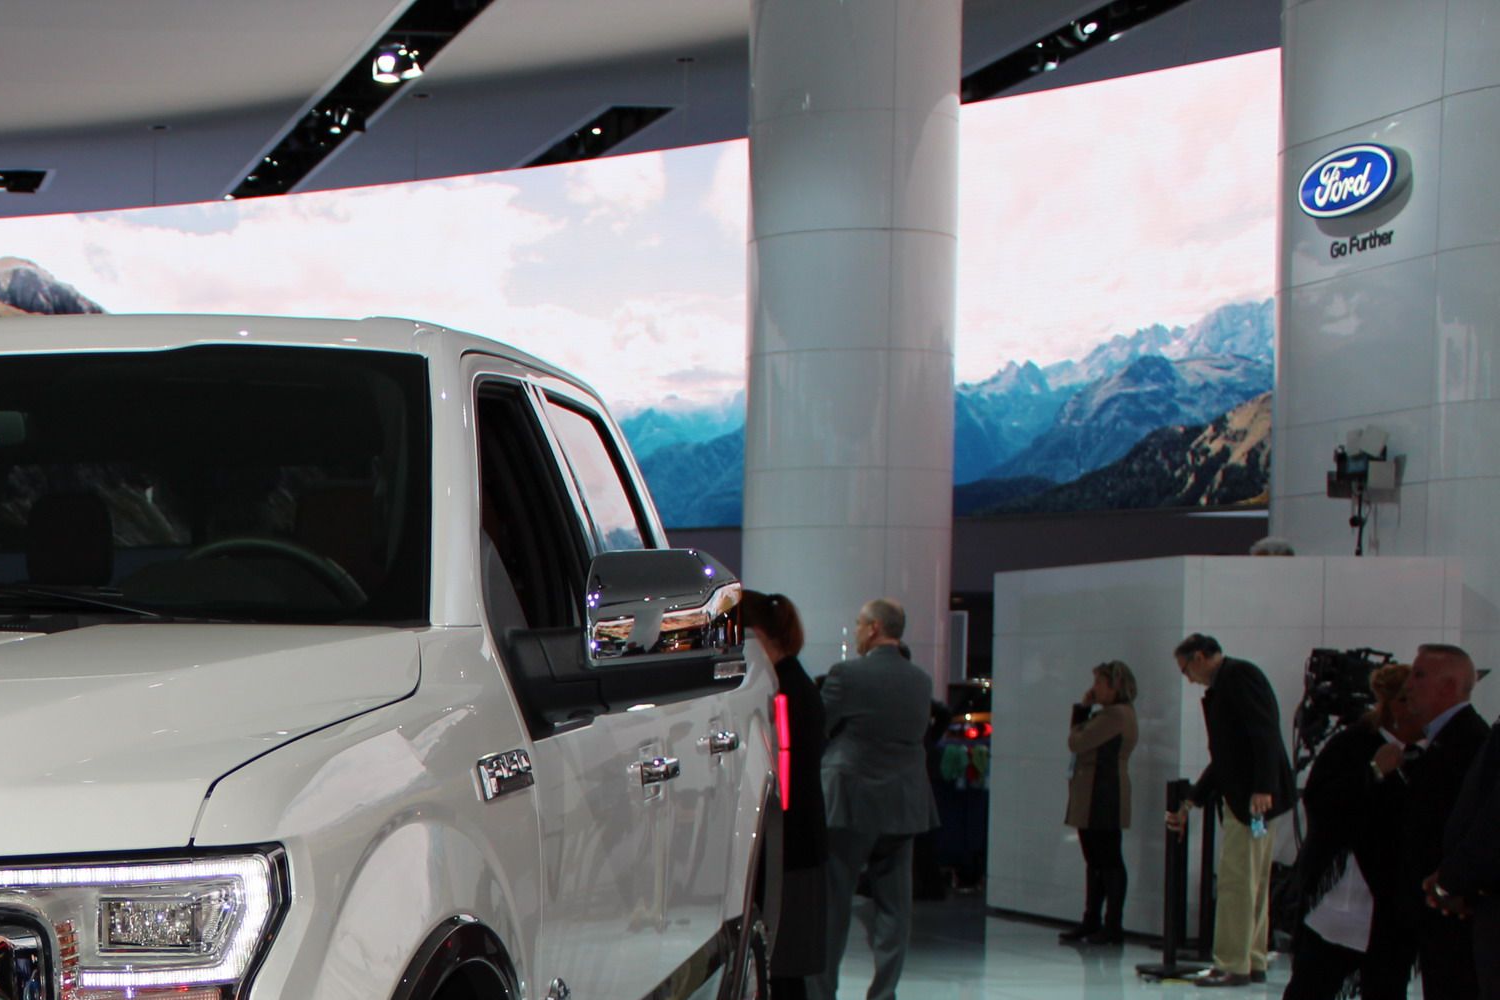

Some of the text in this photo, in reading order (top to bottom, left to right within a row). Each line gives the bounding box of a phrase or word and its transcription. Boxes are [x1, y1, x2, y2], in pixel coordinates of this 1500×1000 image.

[1314, 157, 1372, 207] Ford
[1330, 230, 1394, 258] Go Further
